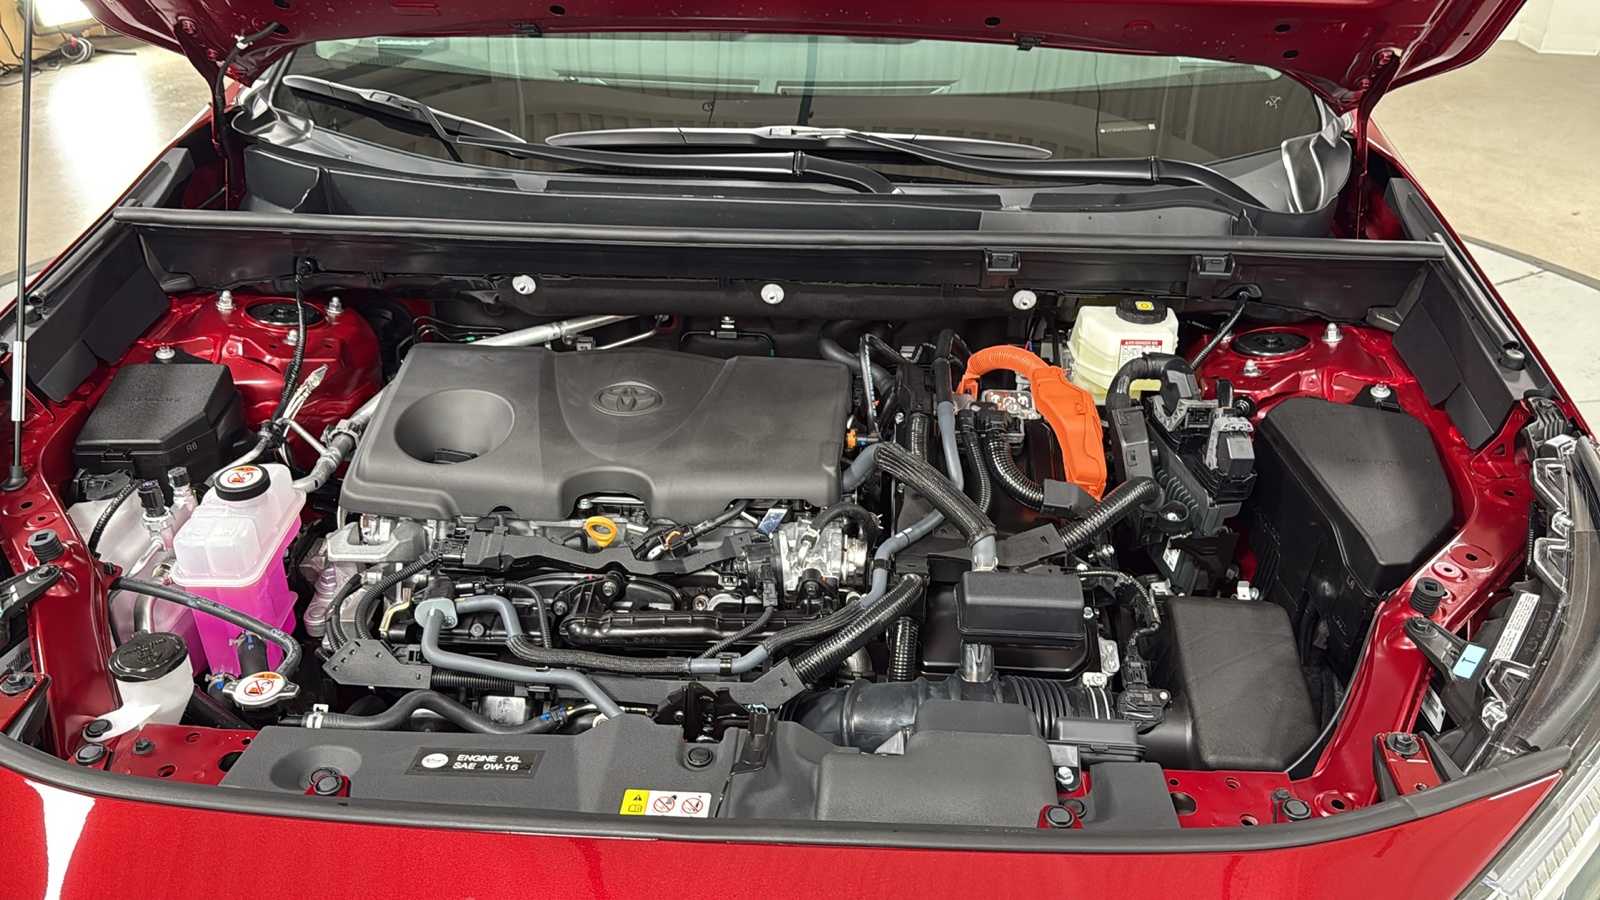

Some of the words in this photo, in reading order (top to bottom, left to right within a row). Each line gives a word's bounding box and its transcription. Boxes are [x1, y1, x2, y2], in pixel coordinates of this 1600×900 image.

[186, 442, 198, 453] R6
[457, 755, 498, 763] ENGINE
[452, 762, 477, 770] SAE
[483, 763, 518, 771] 0W-16
